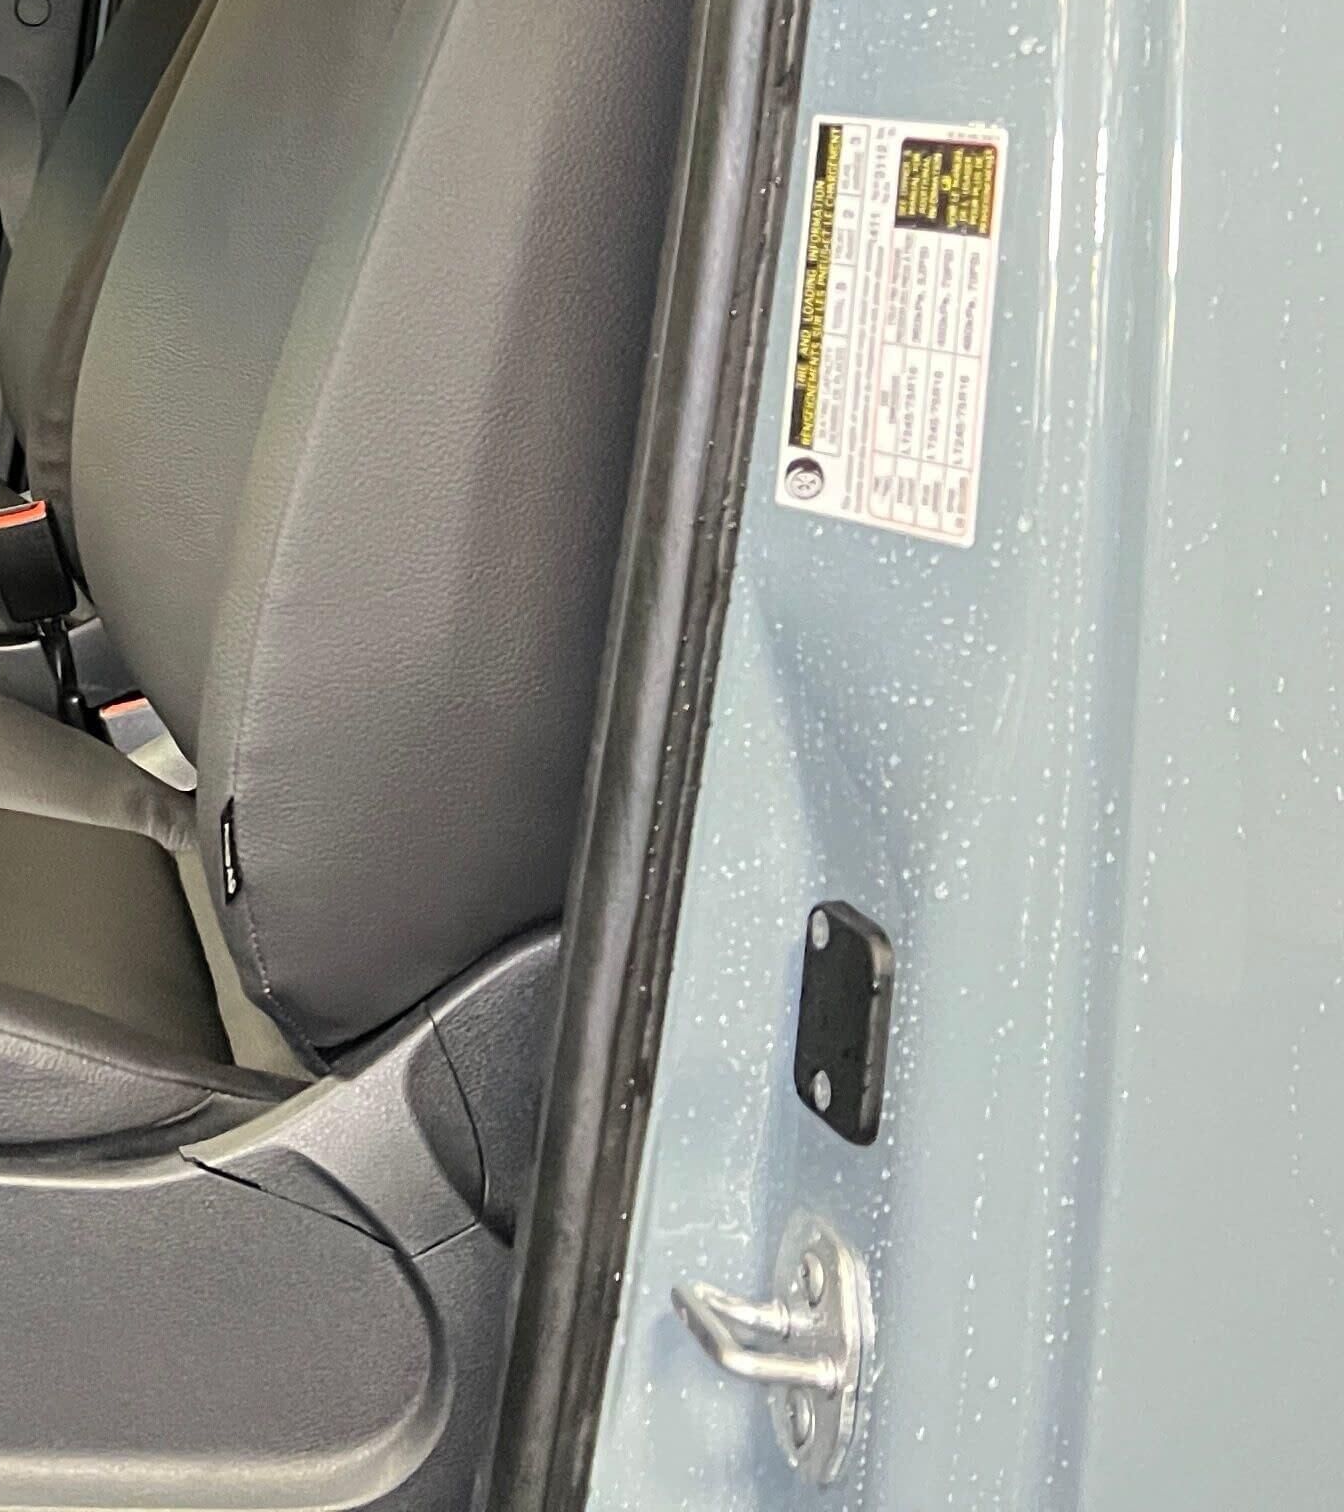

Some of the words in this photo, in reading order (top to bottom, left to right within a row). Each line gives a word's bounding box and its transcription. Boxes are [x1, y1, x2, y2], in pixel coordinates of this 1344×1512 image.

[807, 179, 825, 261] INFORMATION
[801, 269, 816, 321] LOADING
[798, 329, 810, 356] AND
